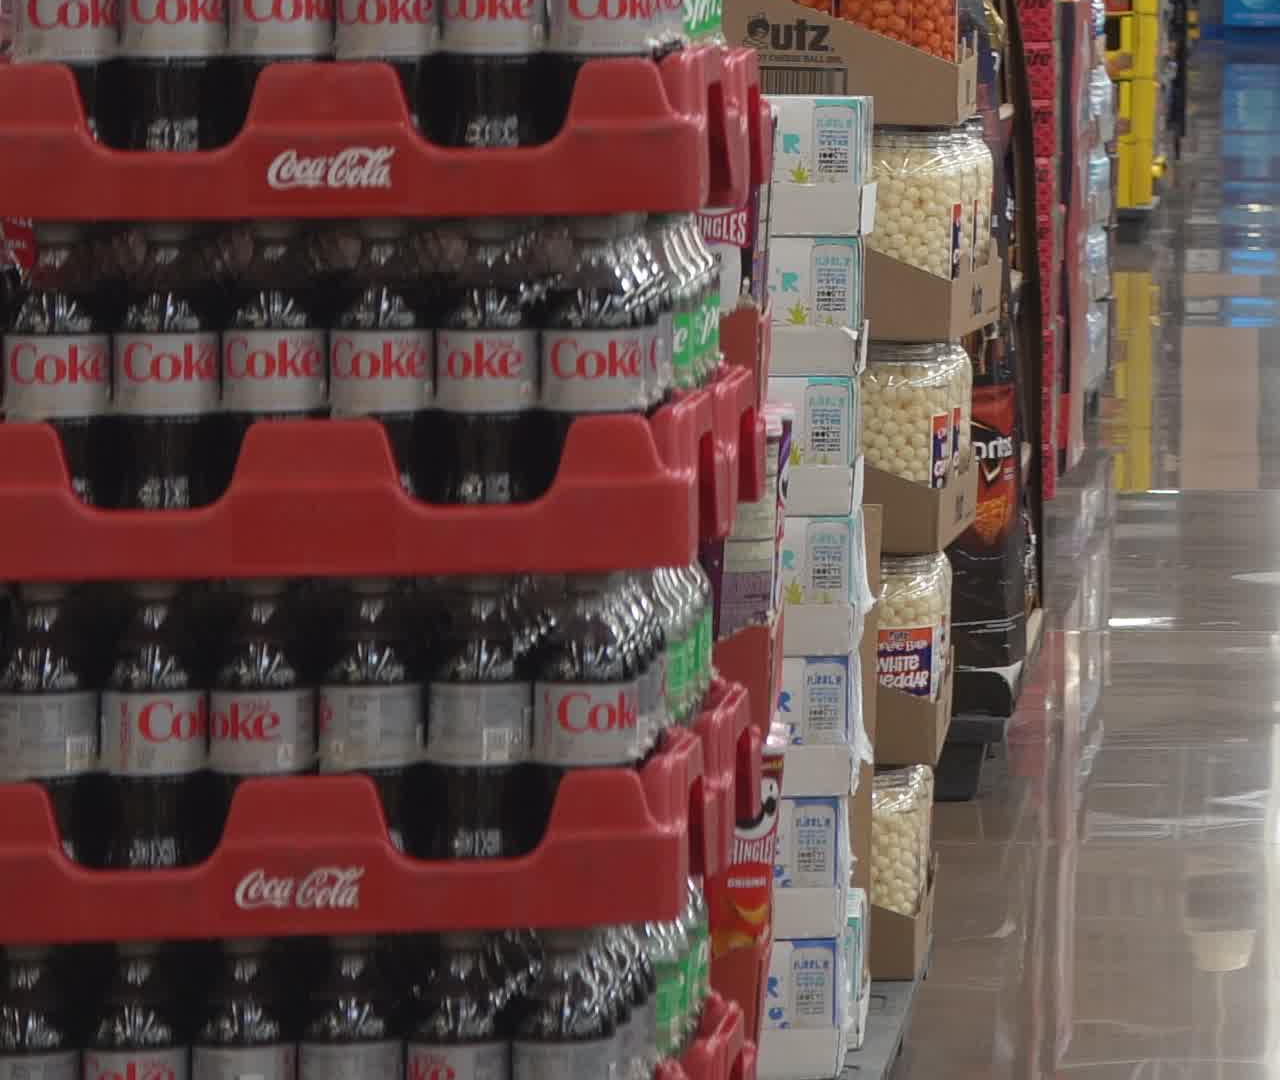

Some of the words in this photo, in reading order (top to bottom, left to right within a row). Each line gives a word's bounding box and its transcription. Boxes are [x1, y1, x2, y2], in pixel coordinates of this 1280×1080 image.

[702, 210, 747, 245] NGLES
[225, 336, 322, 381] Coke
[331, 336, 428, 381] Coke
[446, 339, 524, 380] oke
